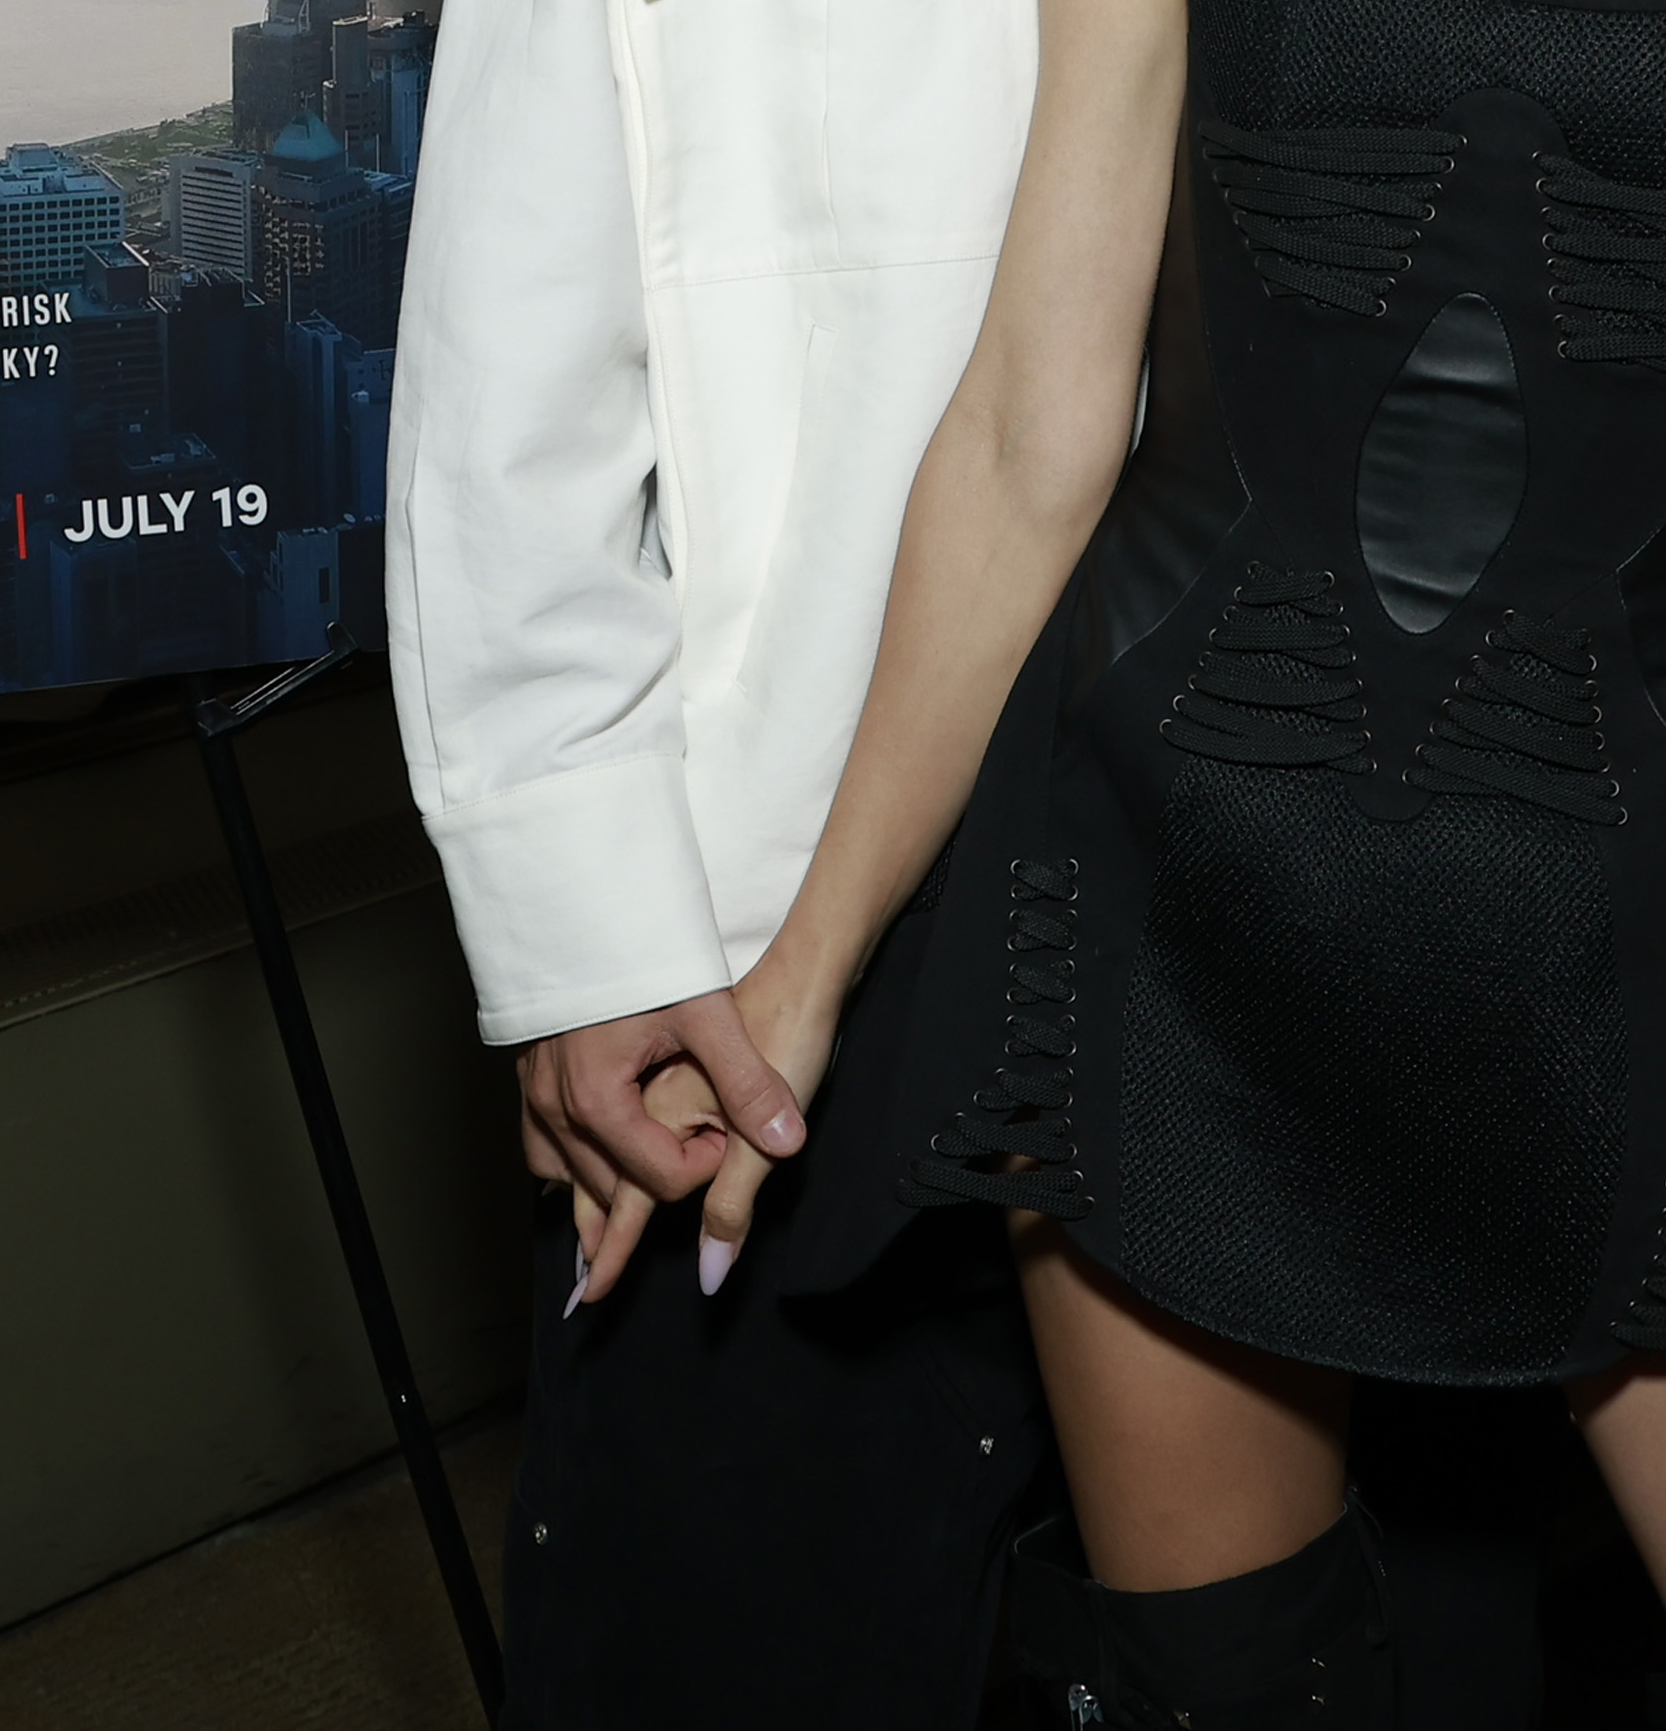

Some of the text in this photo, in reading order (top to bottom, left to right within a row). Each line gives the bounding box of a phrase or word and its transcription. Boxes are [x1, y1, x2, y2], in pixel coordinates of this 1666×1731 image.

[1, 292, 72, 327] RISK
[64, 490, 195, 542] JULY
[212, 484, 268, 527] 19
